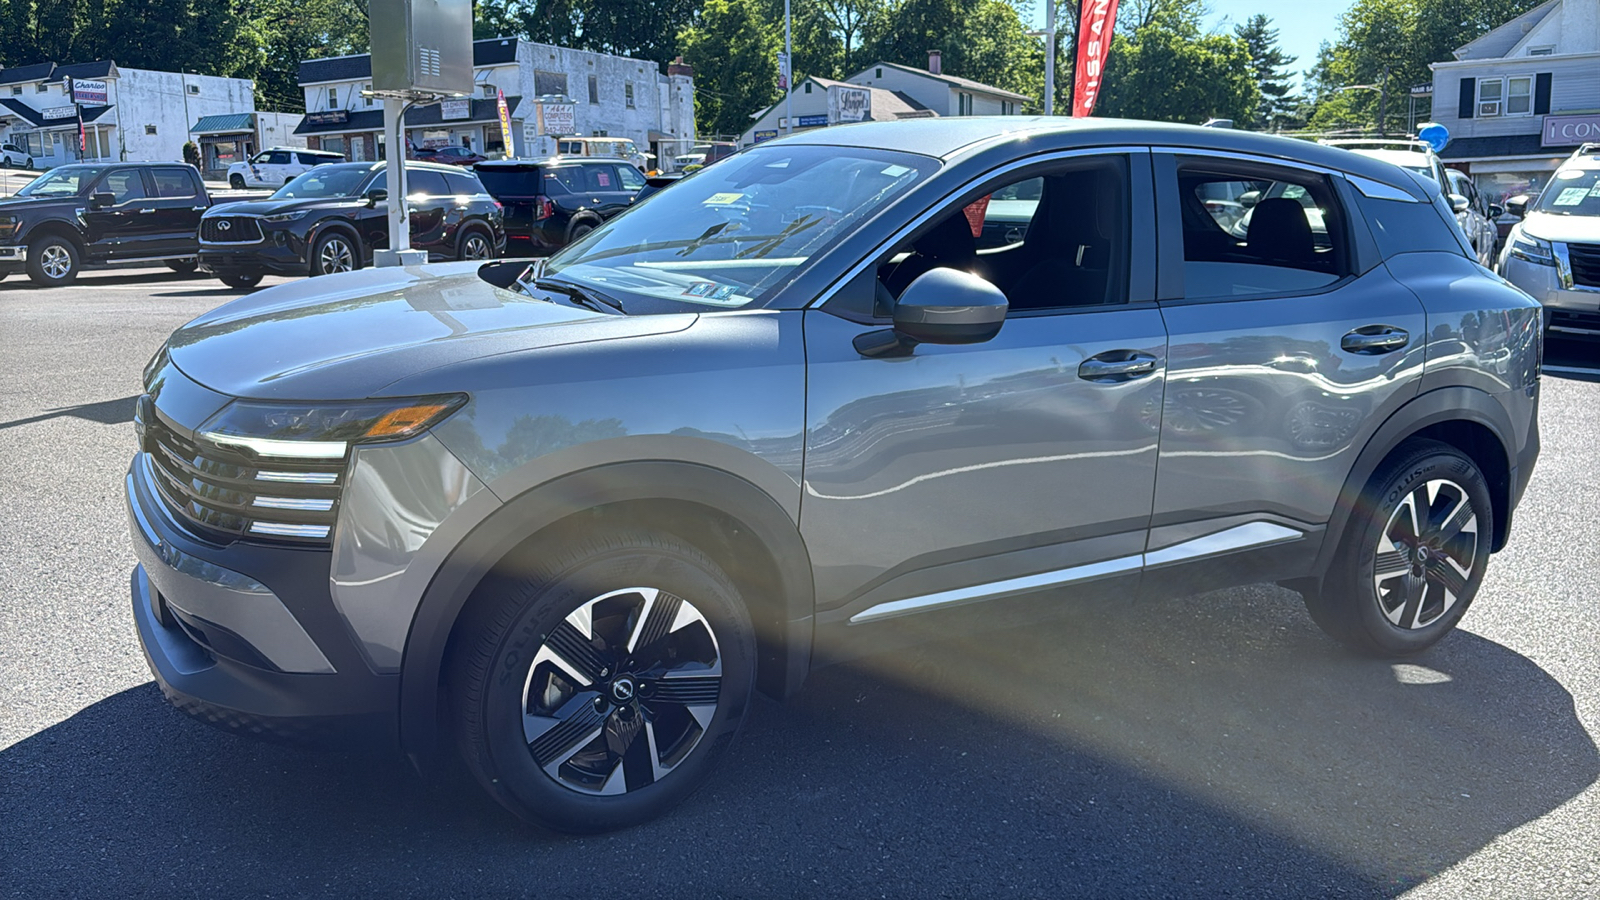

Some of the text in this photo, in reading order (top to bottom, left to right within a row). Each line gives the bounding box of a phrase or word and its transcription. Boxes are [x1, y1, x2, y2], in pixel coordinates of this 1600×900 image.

[1084, 0, 1109, 109] NISSAN
[1411, 86, 1425, 94] HAIR
[499, 107, 512, 156] COMPUTE
[1382, 468, 1424, 513] SOLUS
